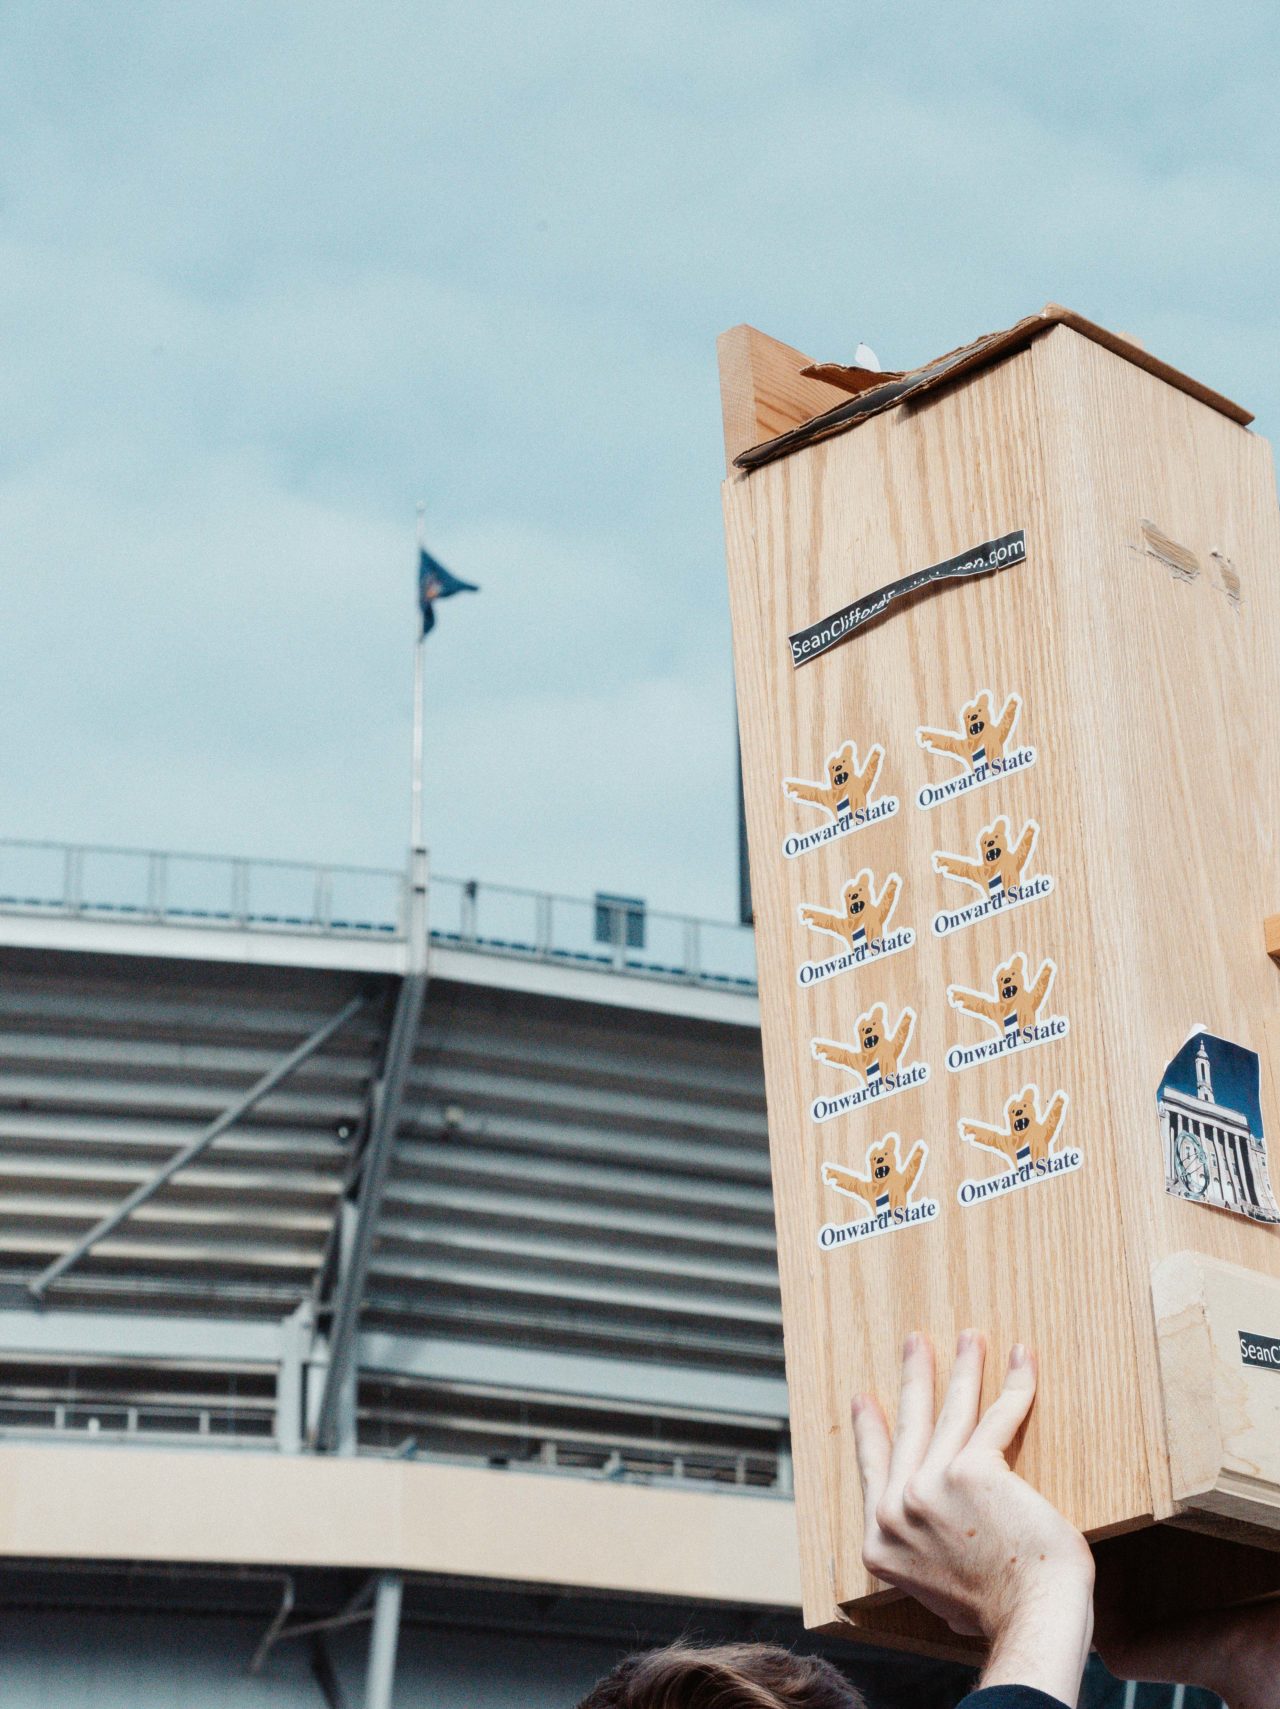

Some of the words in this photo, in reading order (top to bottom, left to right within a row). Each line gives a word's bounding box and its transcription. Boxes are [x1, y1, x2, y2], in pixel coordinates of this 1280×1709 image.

[918, 766, 987, 806] Onward
[989, 750, 1034, 777] State
[784, 815, 852, 856] Onward
[854, 799, 896, 825] State
[934, 893, 1004, 933] Onward
[1005, 878, 1050, 905] State
[799, 944, 867, 984] Onward
[869, 929, 913, 957] State
[948, 1033, 1018, 1068] Onward
[1022, 1019, 1066, 1045] State
[813, 1081, 881, 1119] Onward
[885, 1066, 927, 1092] State
[960, 1166, 1031, 1203] Onward
[1035, 1151, 1080, 1176] State
[821, 1213, 889, 1247] Onward
[893, 1202, 936, 1227] State
